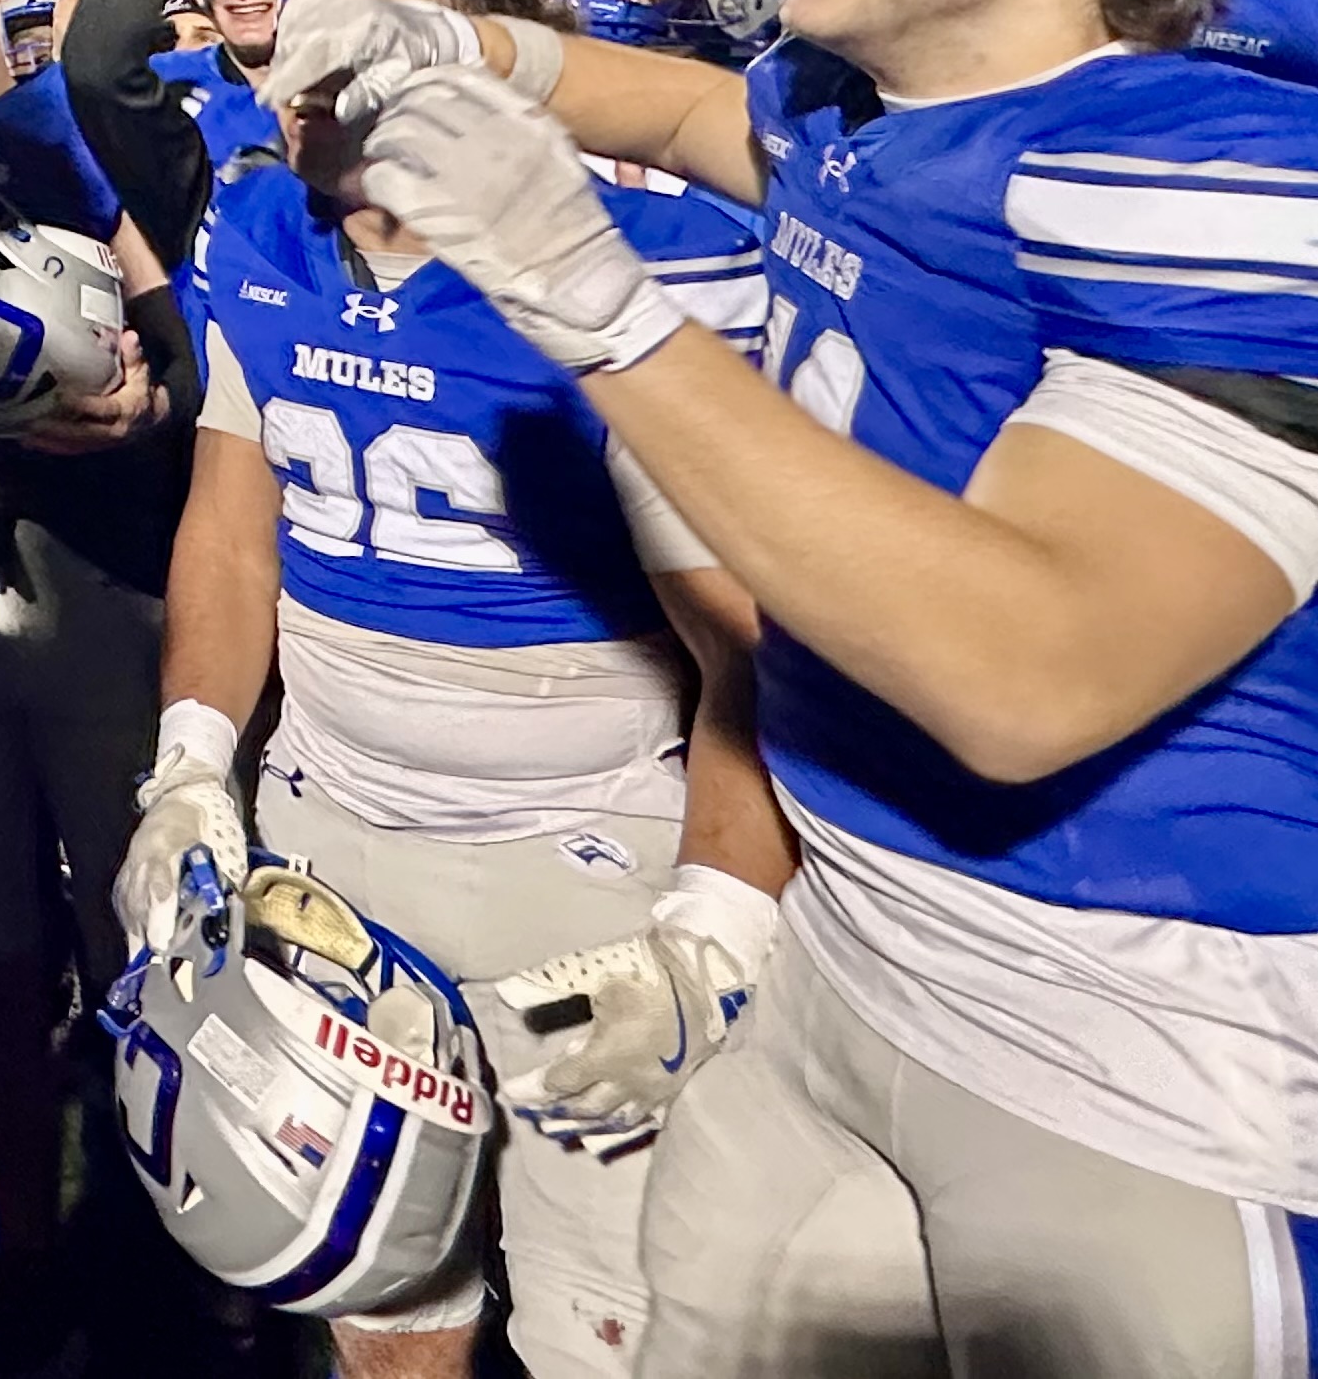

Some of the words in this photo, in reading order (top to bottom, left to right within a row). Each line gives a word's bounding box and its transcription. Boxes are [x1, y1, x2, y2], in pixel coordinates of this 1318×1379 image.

[771, 211, 863, 301] MULES
[292, 343, 436, 402] MULES
[314, 1013, 474, 1125] Riddell
